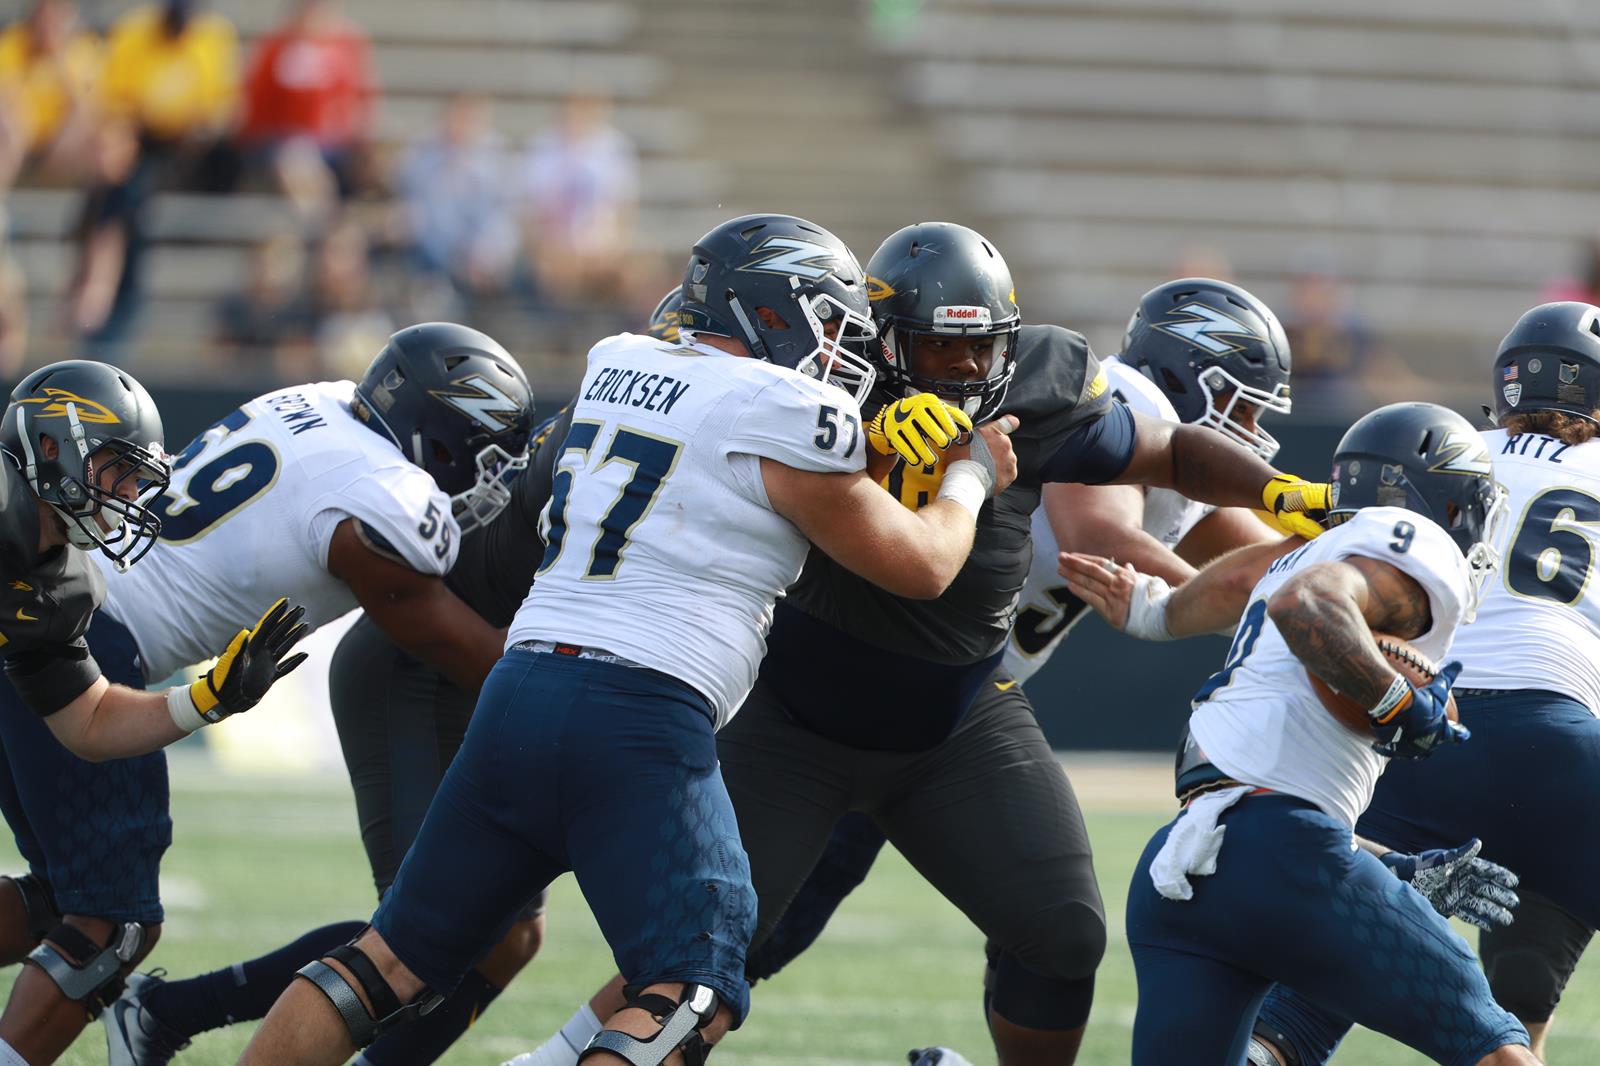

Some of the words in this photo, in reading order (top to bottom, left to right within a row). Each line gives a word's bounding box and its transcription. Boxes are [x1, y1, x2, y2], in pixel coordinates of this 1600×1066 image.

[946, 308, 977, 318] Riddell
[584, 367, 690, 415] ERICKSEN
[814, 403, 859, 460] 57
[1501, 432, 1572, 464] RITZ
[534, 418, 686, 581] 57
[417, 499, 452, 560] 59
[1388, 520, 1416, 554] 9
